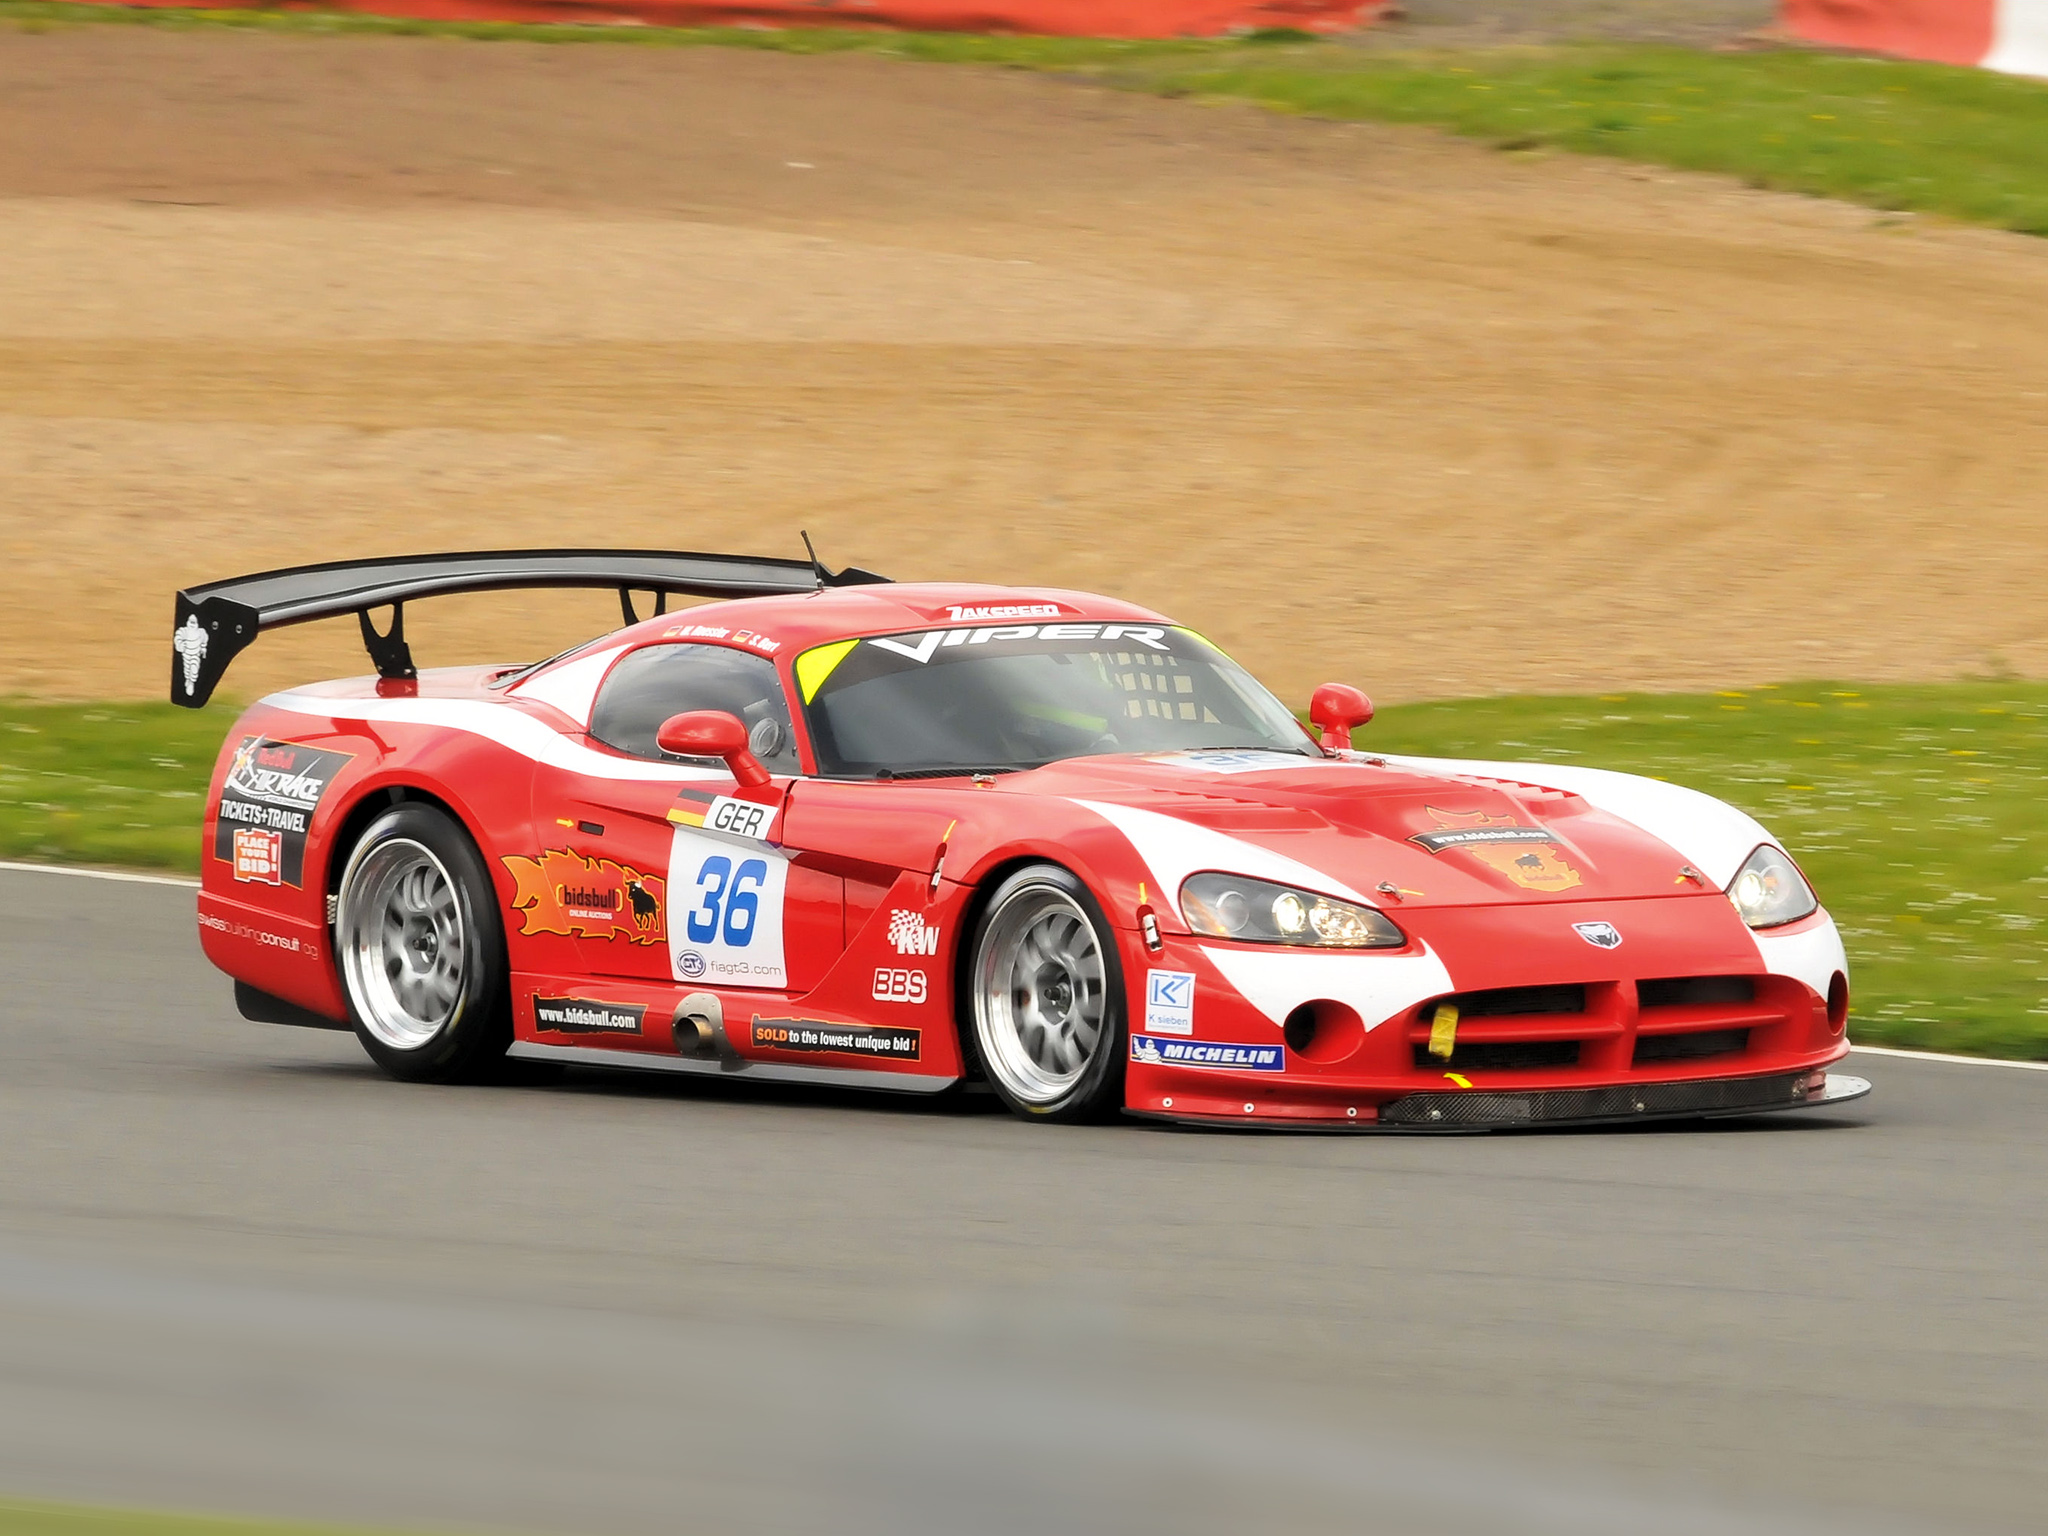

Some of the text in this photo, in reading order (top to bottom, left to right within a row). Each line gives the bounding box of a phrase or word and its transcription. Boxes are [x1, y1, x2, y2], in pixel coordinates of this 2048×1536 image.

[945, 604, 1061, 622] ZAKSPEED
[867, 624, 1171, 664] VIPER
[714, 801, 765, 837] GER
[237, 836, 270, 850] PLACE
[239, 847, 269, 859] YOUR
[238, 857, 271, 874] BID
[564, 884, 616, 908] bidsbull
[687, 855, 768, 947] 36
[897, 926, 940, 956] KW
[711, 961, 782, 976] fiagt3.com
[874, 968, 927, 1004] BBS
[539, 1007, 636, 1029] www.bidsbull.com
[1157, 1015, 1188, 1026] sieben
[756, 1027, 788, 1042] SOLD
[788, 1029, 800, 1043] to
[801, 1031, 818, 1045] the
[819, 1032, 853, 1047] lowest
[854, 1035, 891, 1052] unique
[892, 1036, 910, 1051] bid
[1163, 1043, 1277, 1064] MICHELIN
